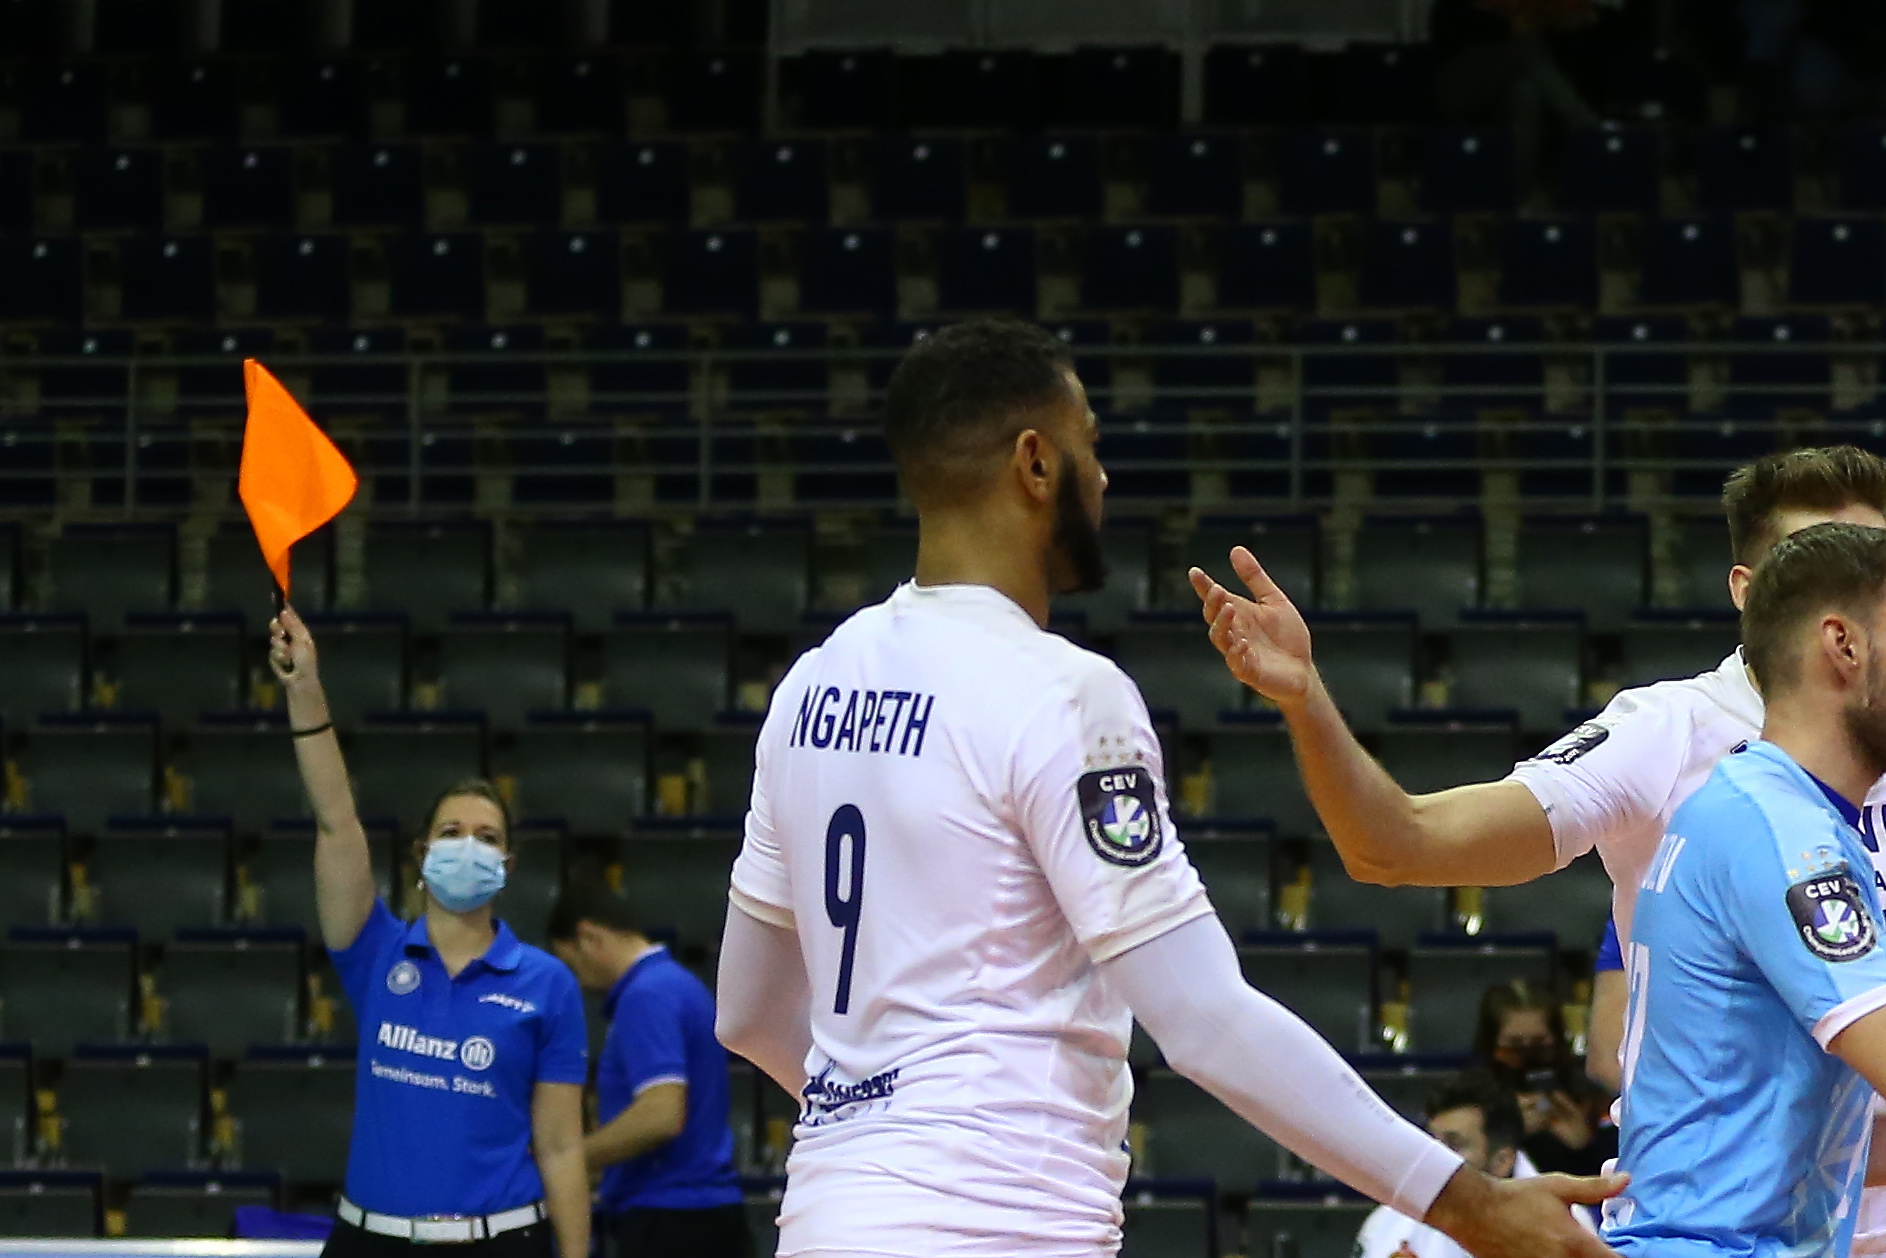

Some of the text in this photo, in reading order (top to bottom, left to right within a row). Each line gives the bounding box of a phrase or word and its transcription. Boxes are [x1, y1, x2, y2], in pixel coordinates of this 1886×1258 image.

[790, 685, 935, 757] NGAPETH
[1098, 773, 1138, 792] CEV
[824, 803, 867, 1016] 9
[1805, 879, 1841, 899] CEV
[377, 1021, 459, 1062] Allianz
